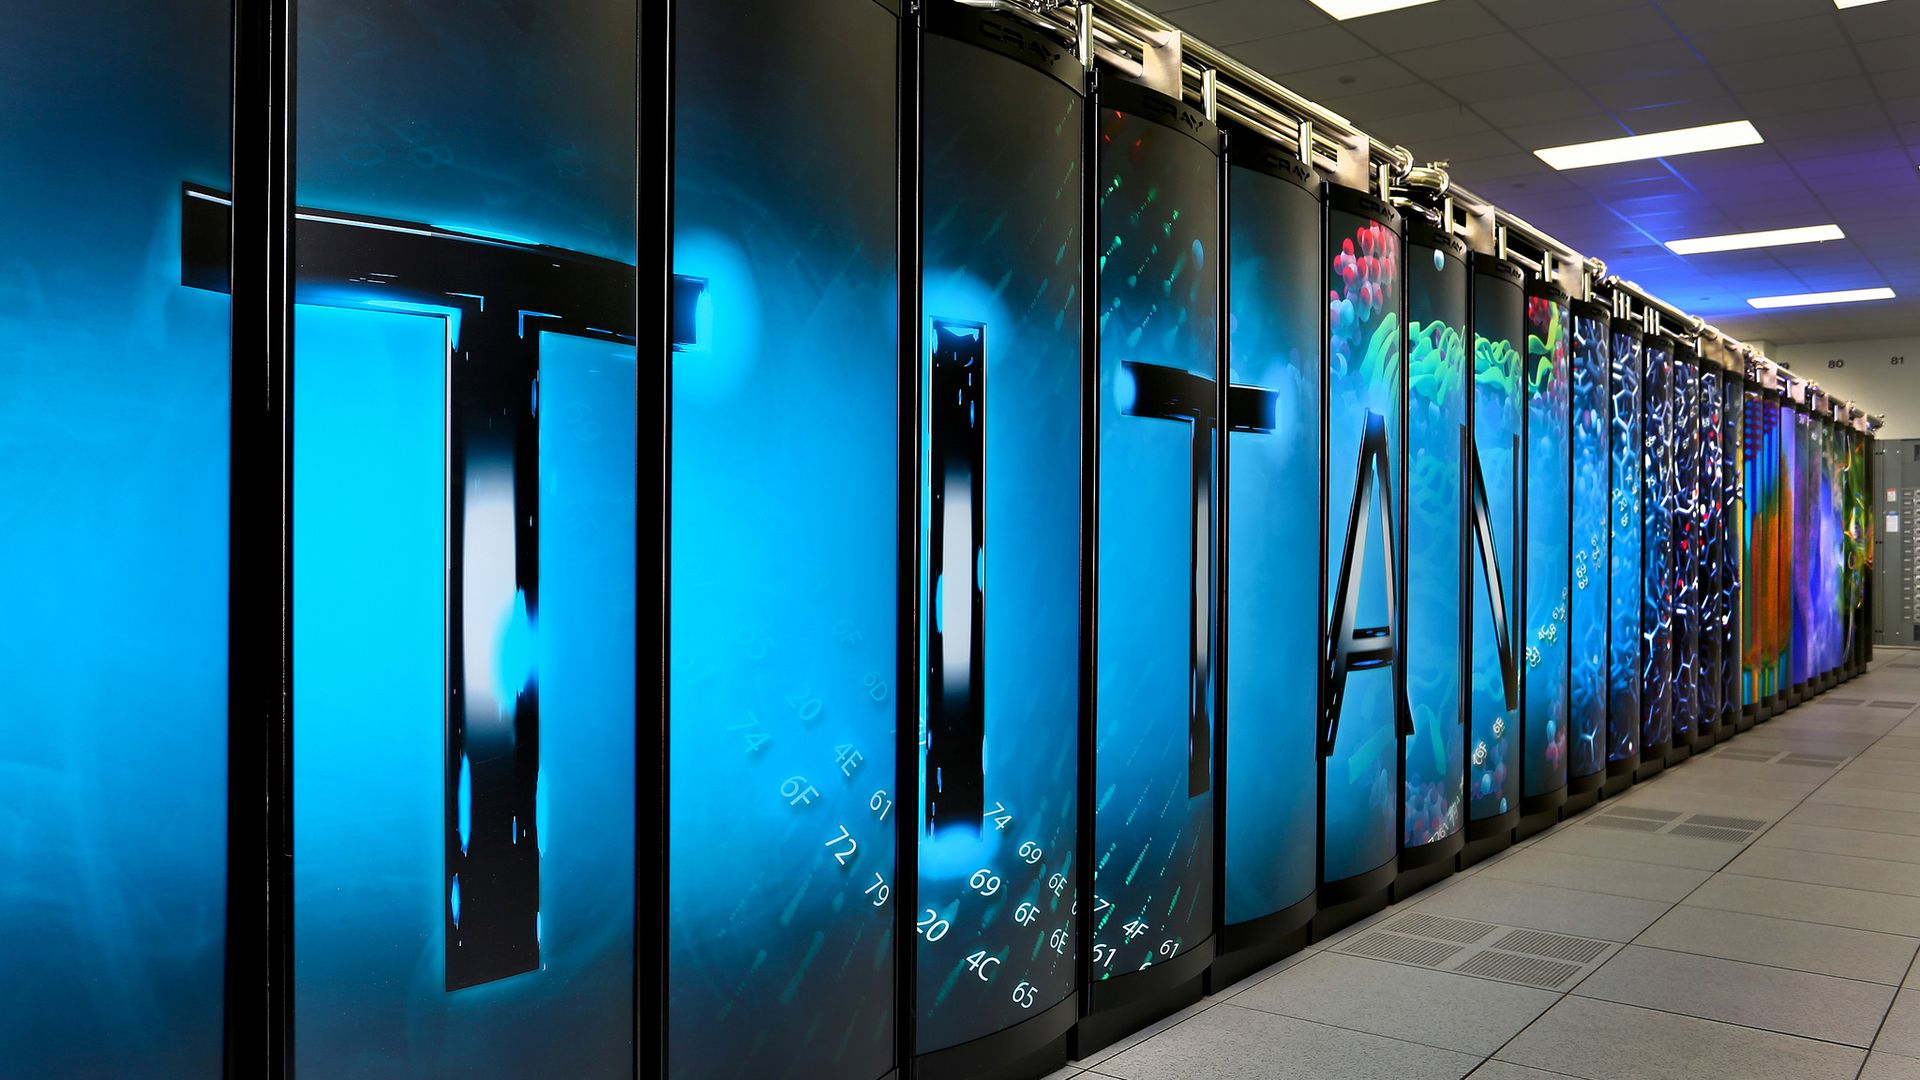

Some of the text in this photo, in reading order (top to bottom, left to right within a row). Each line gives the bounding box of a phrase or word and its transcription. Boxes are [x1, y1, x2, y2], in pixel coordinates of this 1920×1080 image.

[979, 18, 1061, 65] CRAY
[1143, 95, 1204, 132] CRAY
[1265, 152, 1310, 182] CRAY
[1359, 197, 1395, 222] CRAY
[1433, 232, 1463, 252] CRAY
[1828, 359, 1844, 369] 80
[1891, 356, 1904, 365] 81
[181, 181, 1519, 992] TITAN
[726, 709, 771, 752] 74
[834, 743, 863, 776] 4E
[780, 775, 819, 806] 6F
[870, 790, 892, 821] 61
[984, 802, 1012, 831] 74
[825, 825, 857, 865] 72
[1018, 841, 1042, 865] 69
[865, 872, 889, 907] 79
[969, 868, 1000, 897] 69
[1048, 872, 1067, 897] 6E
[917, 908, 950, 942] 20
[1014, 902, 1040, 927] 6F
[1050, 928, 1069, 954] 6E
[1122, 920, 1149, 939] 4F
[1159, 939, 1179, 959] 61
[966, 950, 1000, 982] 4C
[1012, 981, 1038, 1009] 65
